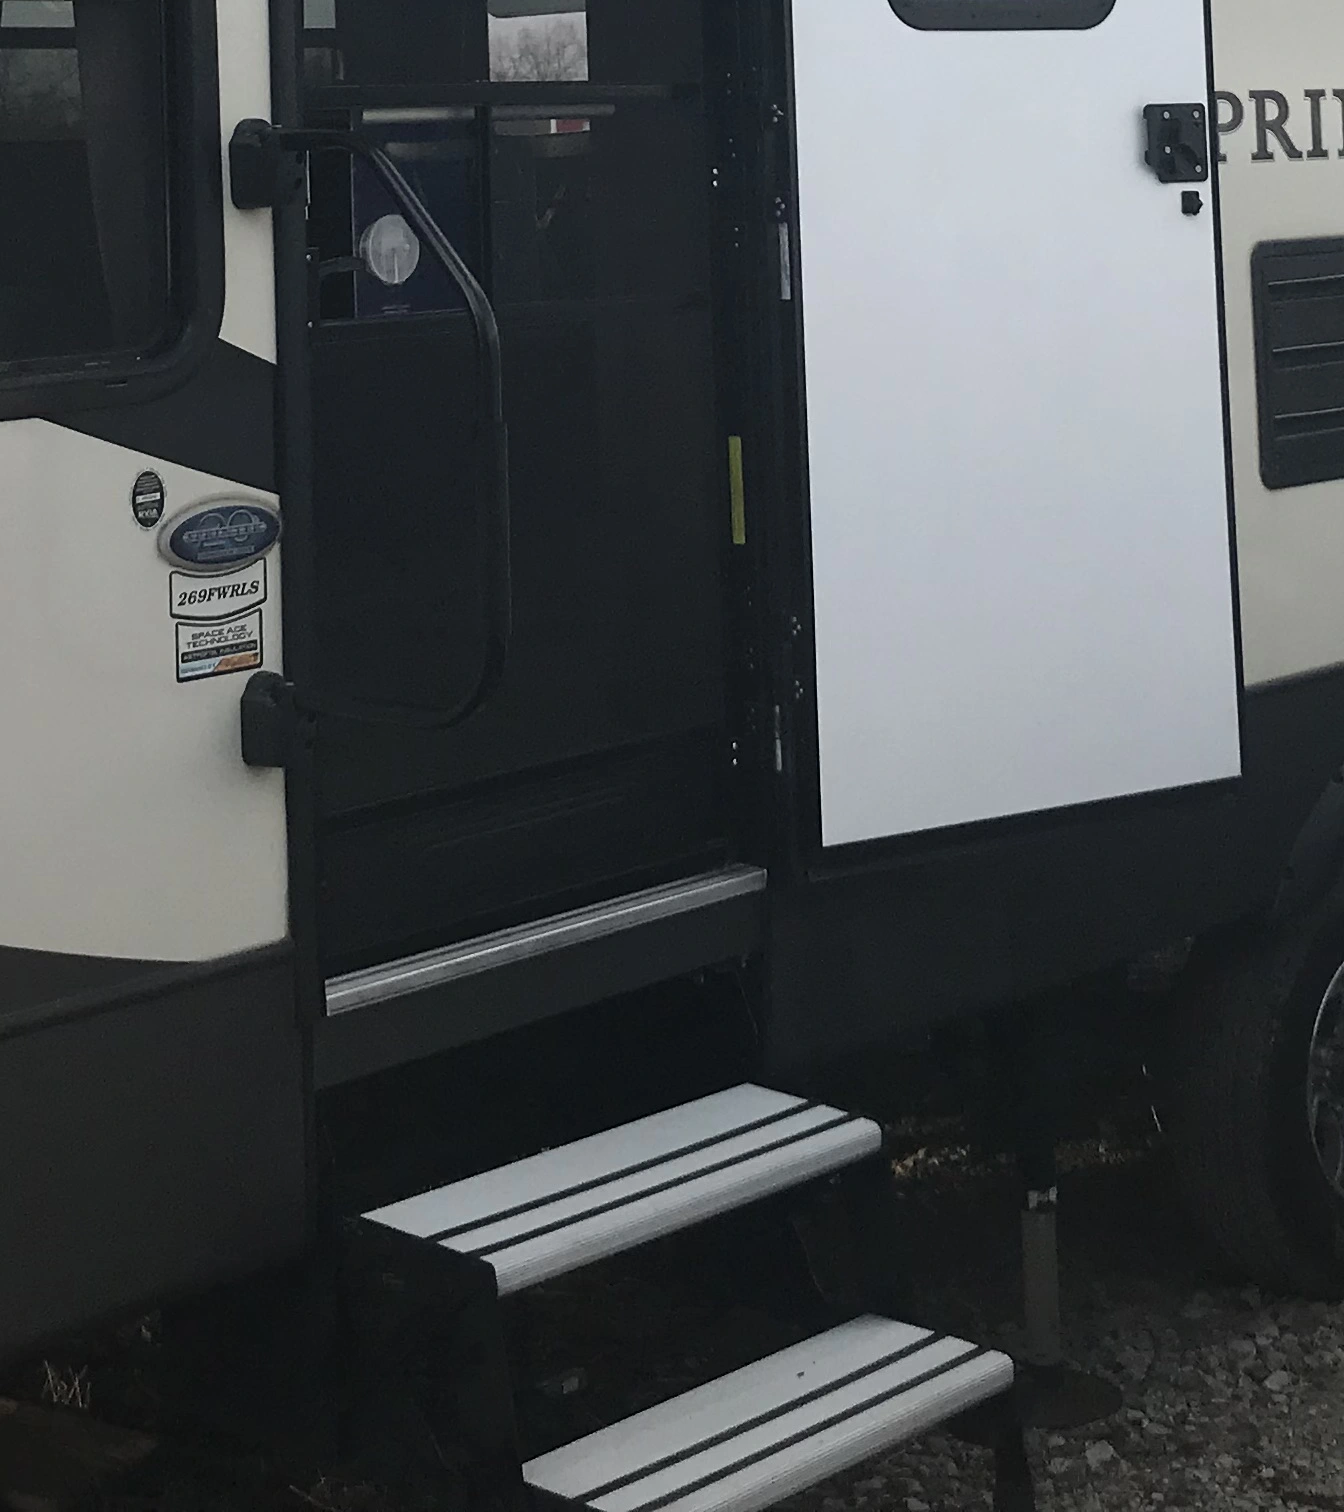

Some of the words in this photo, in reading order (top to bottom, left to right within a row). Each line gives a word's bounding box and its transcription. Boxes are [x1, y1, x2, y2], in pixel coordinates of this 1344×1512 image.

[177, 580, 261, 607] 269FWRLS
[186, 630, 254, 649] TECHNOLOGY
[191, 628, 225, 641] SPACE
